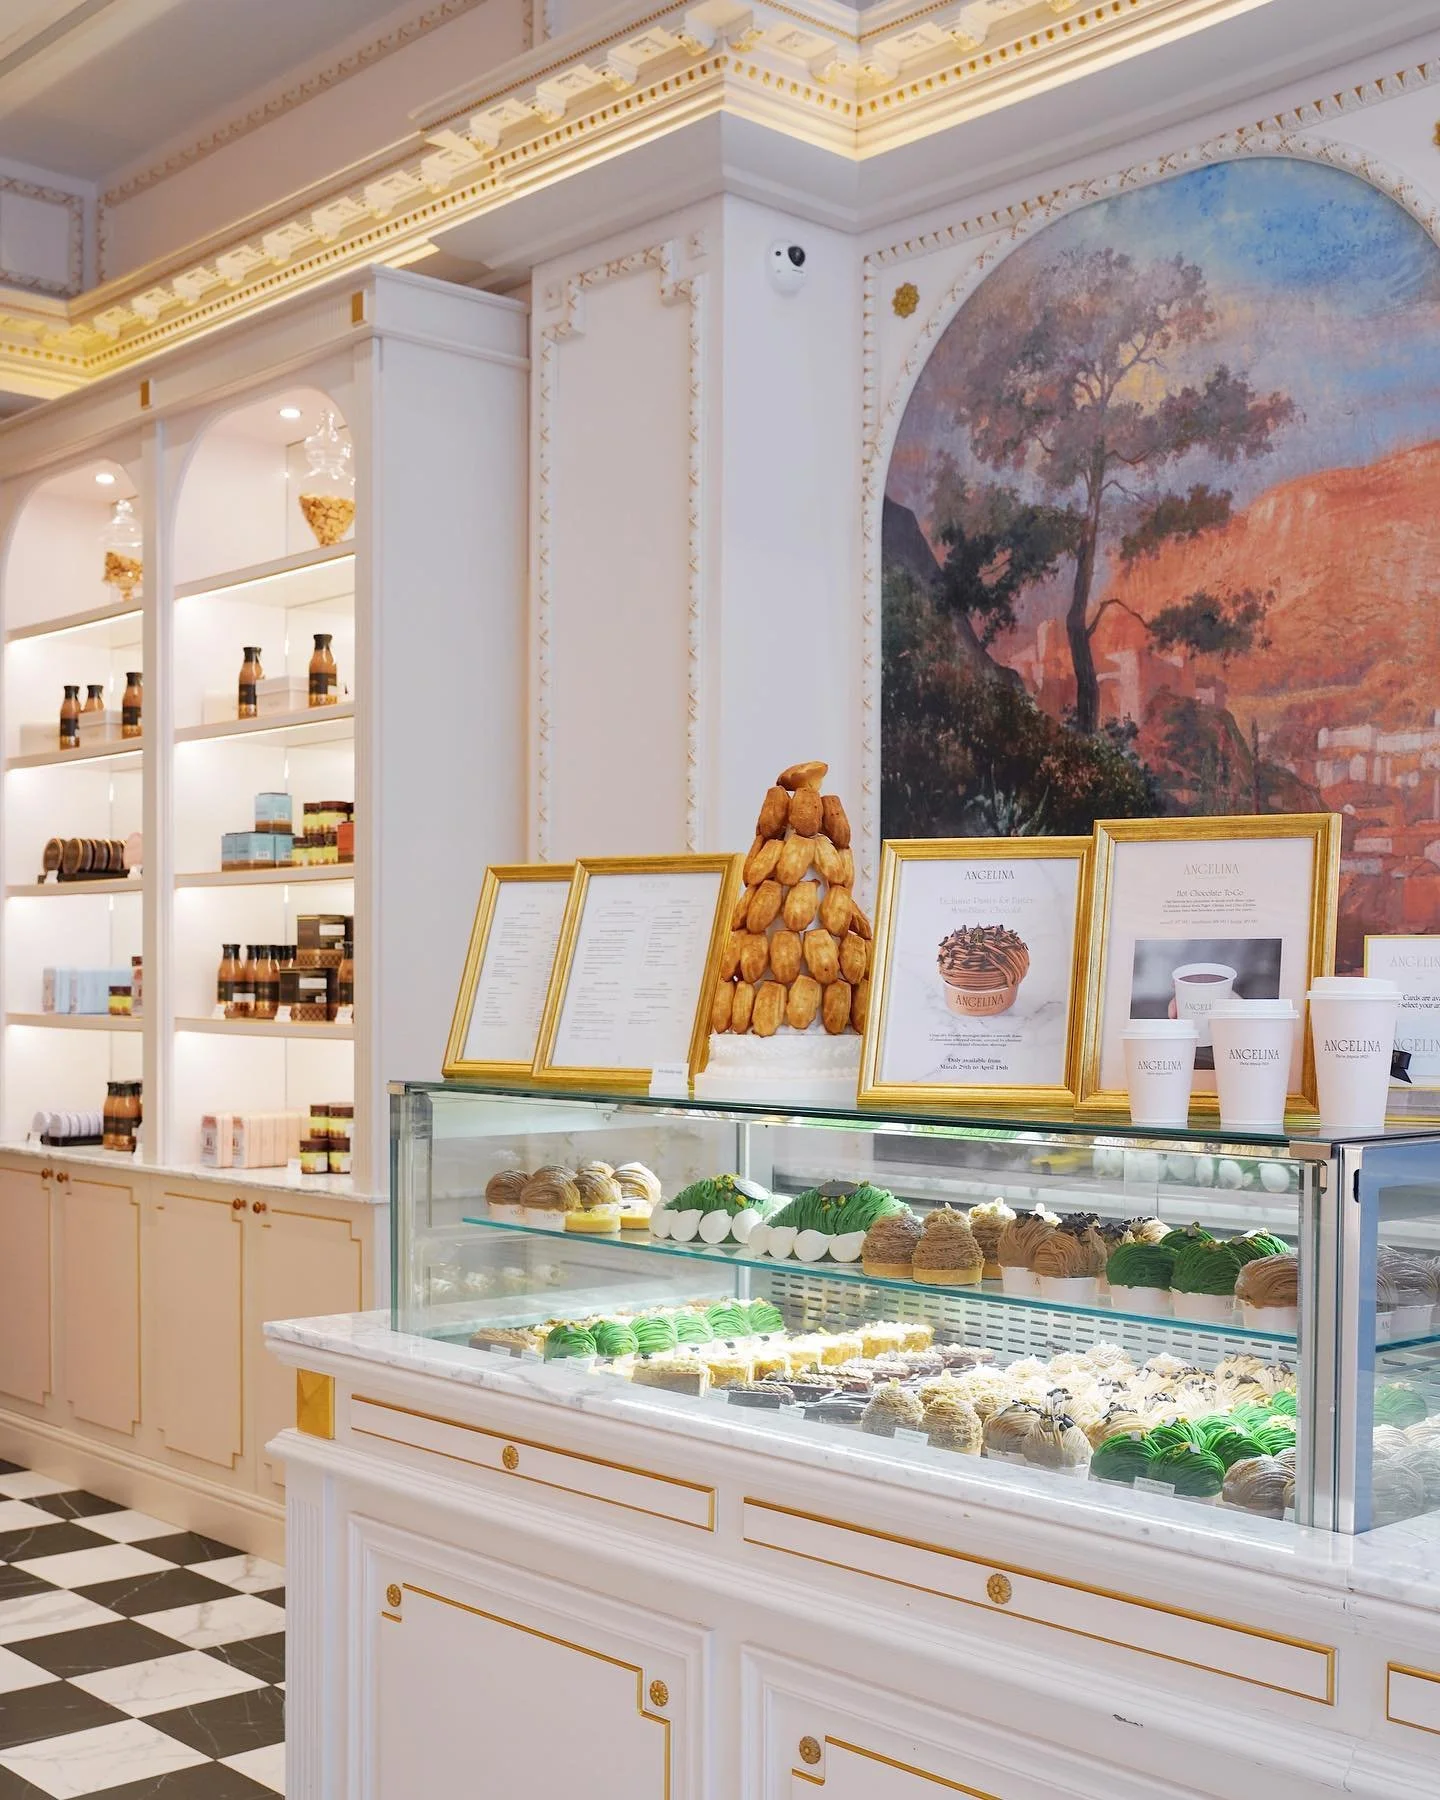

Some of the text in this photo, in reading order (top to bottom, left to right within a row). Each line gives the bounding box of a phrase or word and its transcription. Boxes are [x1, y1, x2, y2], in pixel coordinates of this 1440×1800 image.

[1183, 863, 1240, 875] ANGELINA
[964, 870, 1015, 881] ANGELINA
[956, 994, 1004, 1008] ANGELINA
[1324, 1039, 1381, 1052] ANGELINA
[1229, 1048, 1280, 1060] ANGELINA
[1137, 1060, 1182, 1070] ANGELINA
